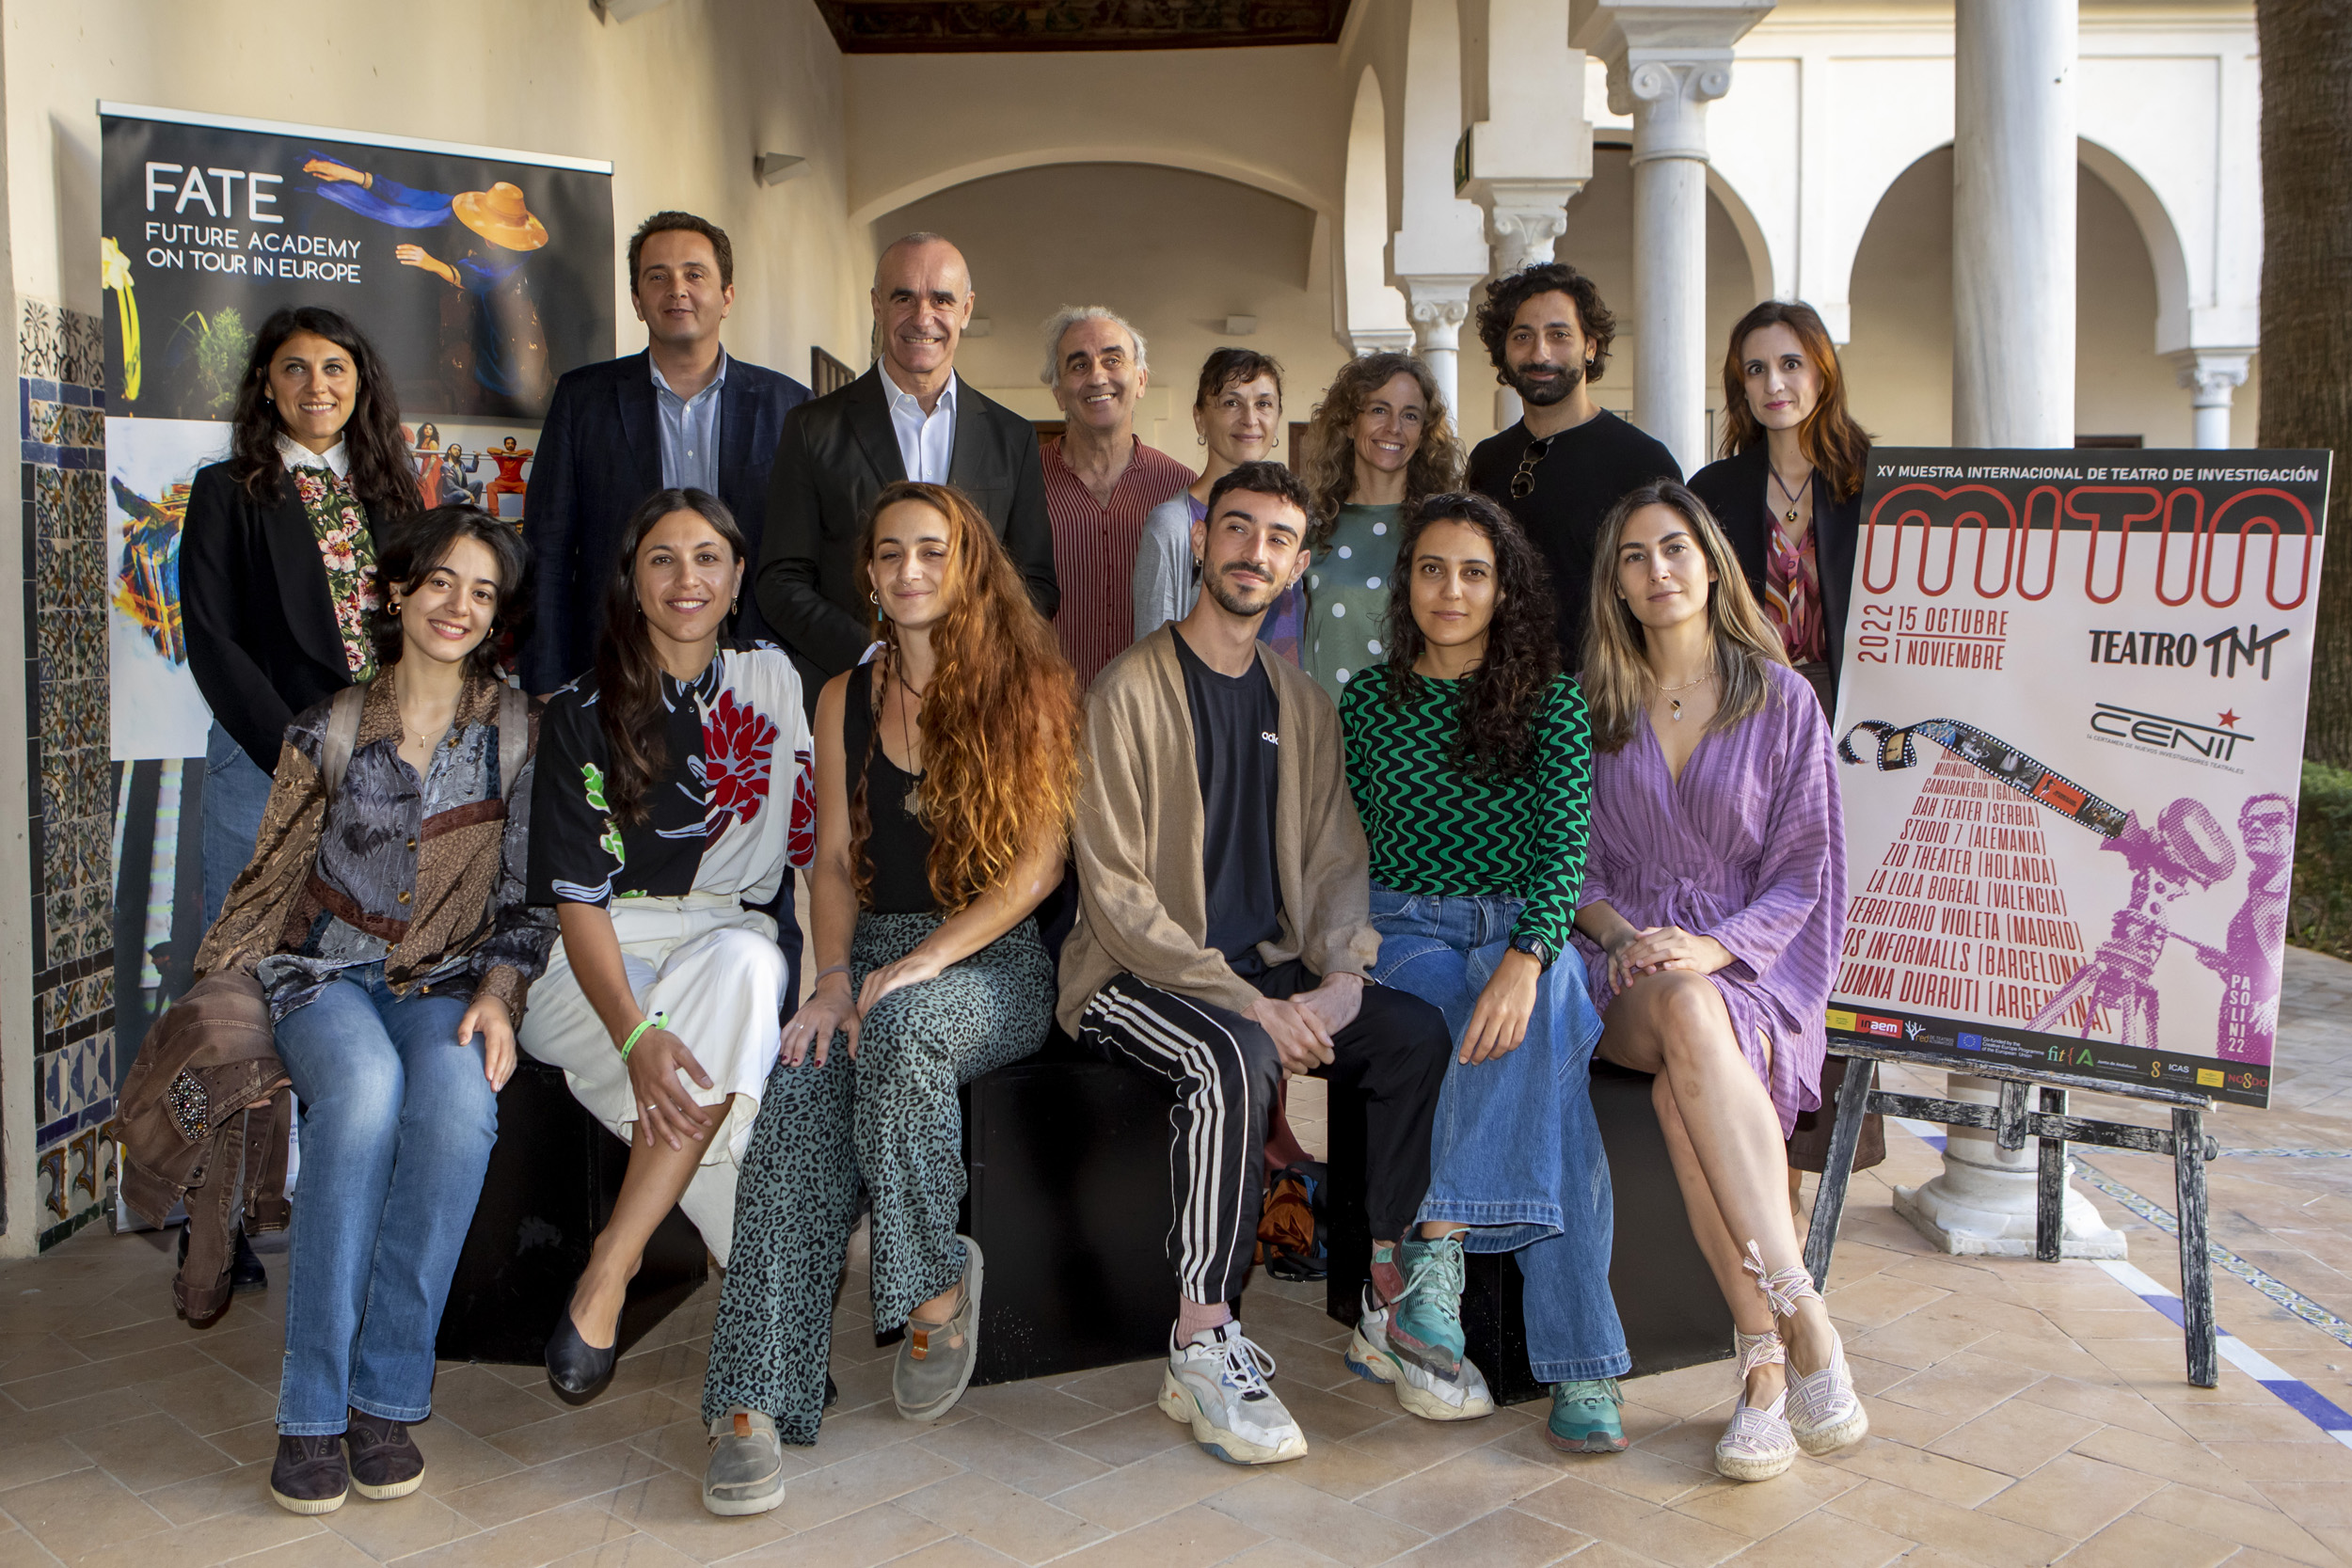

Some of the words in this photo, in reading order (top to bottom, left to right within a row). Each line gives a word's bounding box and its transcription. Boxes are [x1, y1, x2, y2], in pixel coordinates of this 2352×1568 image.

[146, 161, 283, 224] FATE
[146, 221, 239, 248] FUTURE
[248, 231, 361, 259] ACADEMY
[146, 247, 183, 269] ON
[189, 250, 247, 275] TOUR
[254, 256, 273, 277] IN
[279, 259, 361, 283] EUROPE
[1877, 465, 1896, 478] XV
[1899, 466, 1963, 479] MUESTRA
[1967, 467, 2083, 480] INTERNACIONAL
[2087, 467, 2107, 481] DE
[2111, 467, 2169, 482] TEATRO
[2172, 468, 2194, 482] DE
[2198, 466, 2319, 483] INVESTIGACIÓN
[1857, 604, 1893, 663] 2022
[1899, 605, 1917, 631] 15
[1925, 607, 2009, 636] OCTUBRE
[1895, 639, 1900, 664] 1
[1907, 640, 2005, 671] NOVIEMBRE
[2089, 629, 2197, 668] TEATRO
[2202, 624, 2290, 681] TNT
[2090, 702, 2255, 762] CENIT
[1933, 762, 1976, 779] MIRIÑAQUE
[2093, 735, 2124, 747] CERTAMEN
[2210, 762, 2245, 775] TEATRALES
[1922, 777, 1988, 800] CAMARANEGRA
[1912, 796, 1939, 817] DAH
[1941, 799, 1982, 822] TEATER
[1987, 801, 2041, 829] (SERBIA)
[1899, 818, 1949, 844] STUDIO
[1954, 823, 1963, 845] 7
[1968, 823, 2047, 856] (ALEMANIA)
[1882, 842, 1910, 867] ZID
[1912, 845, 1972, 876] THEATER
[1979, 850, 2058, 886] (HOLANDA)
[1867, 869, 1887, 894] LA
[1887, 871, 1925, 898] LOLA
[1928, 876, 1980, 906] BOREAL
[1987, 880, 2068, 917] (VALENCIA)
[1847, 895, 1936, 932] TERRITORIO
[1941, 907, 2000, 942] VIOLETA
[2007, 912, 2085, 953] (MADRID)
[1867, 930, 1970, 973] INFORMALLS
[1899, 970, 1980, 1013] DURRUTI
[1861, 1019, 1898, 1034] inaem
[1915, 1034, 1929, 1043] red
[2228, 1037, 2245, 1053] 22
[2046, 1046, 2065, 1062] fit
[2169, 1063, 2189, 1073] ICAS
